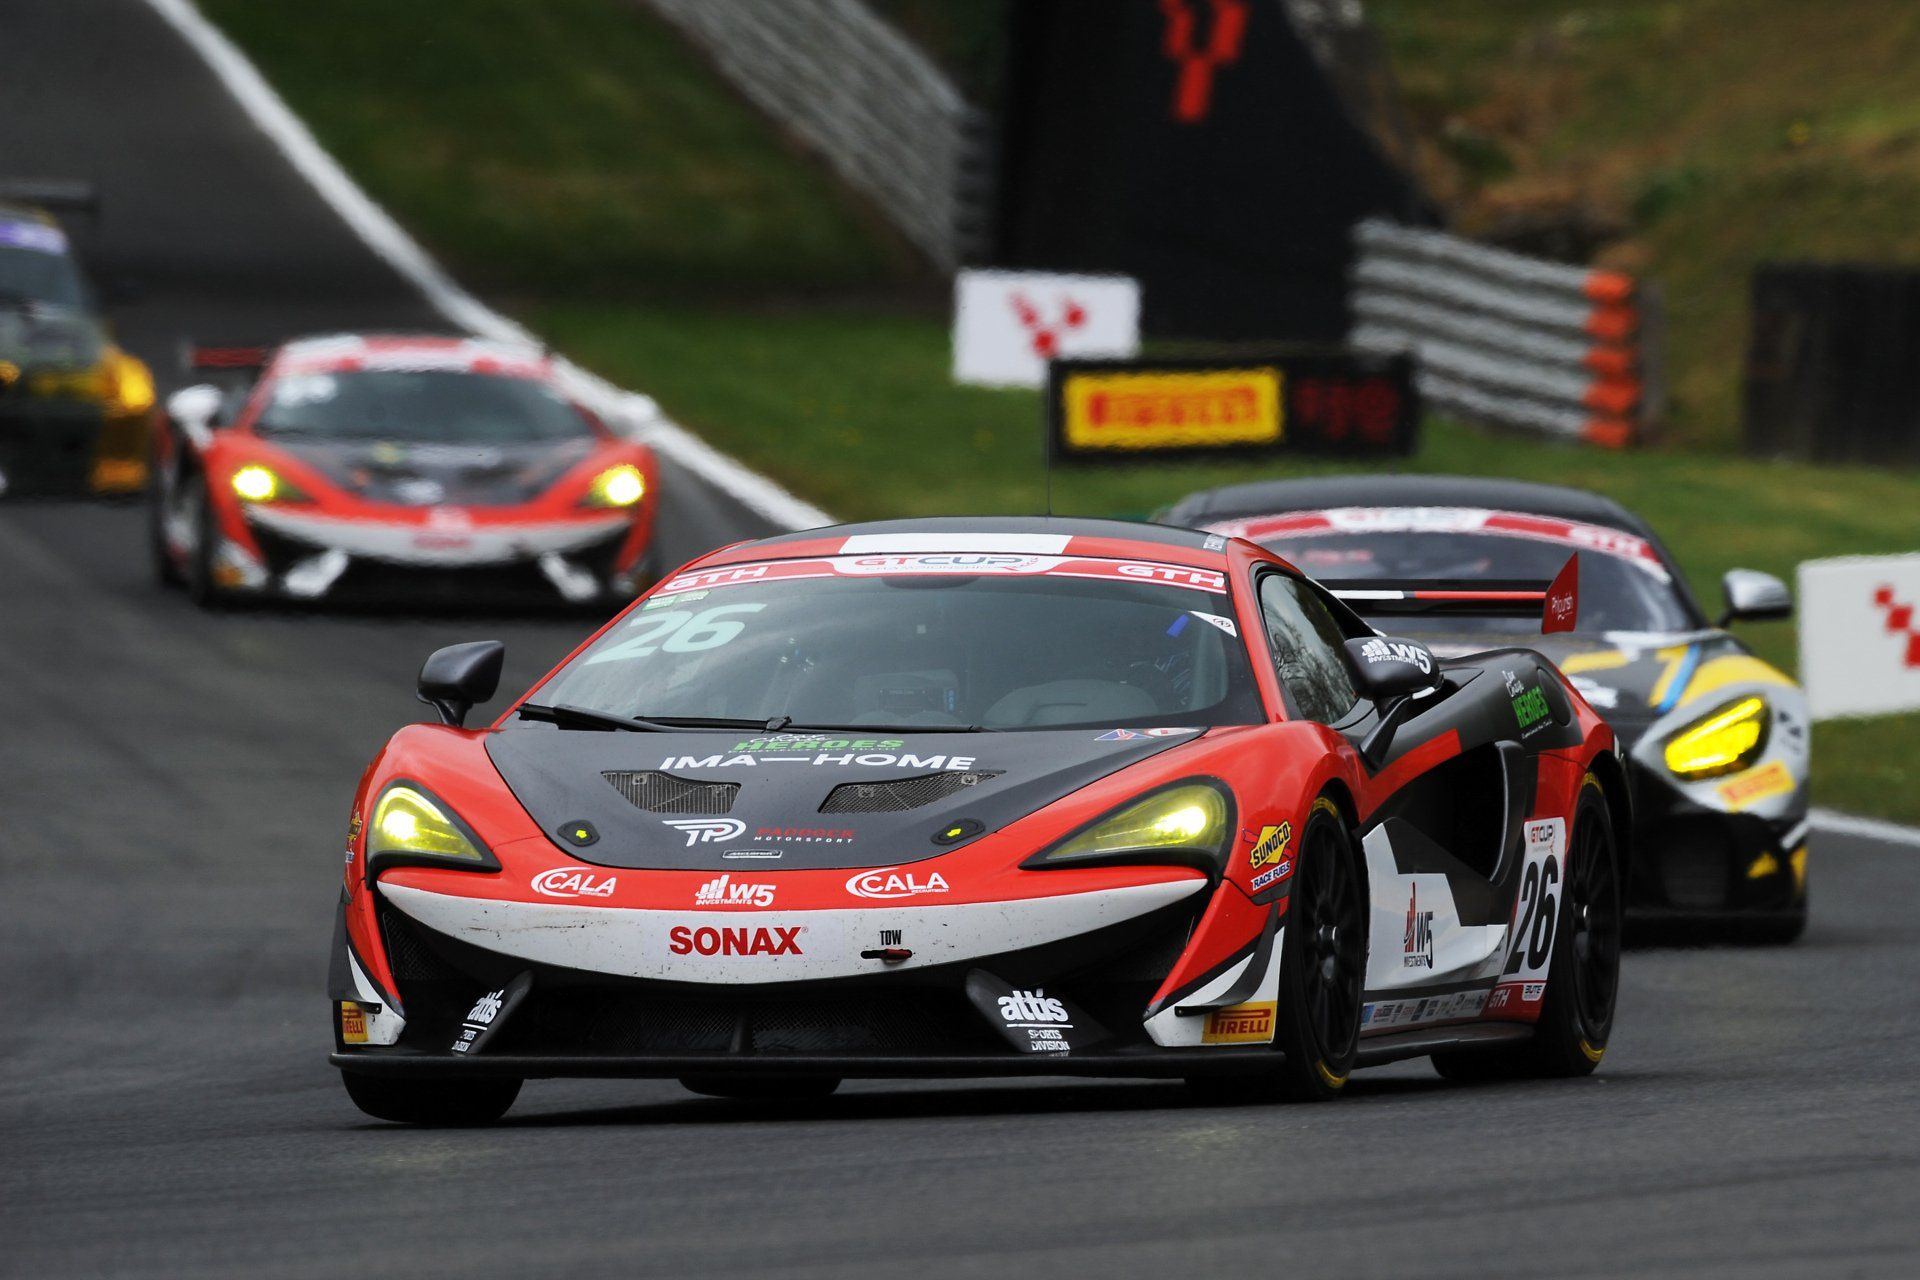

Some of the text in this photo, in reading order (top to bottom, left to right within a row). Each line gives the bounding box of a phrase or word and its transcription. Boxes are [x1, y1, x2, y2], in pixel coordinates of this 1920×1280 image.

[663, 566, 770, 591] GTH
[1117, 565, 1225, 588] GTH
[583, 603, 769, 666] 26
[1368, 654, 1419, 667] INVESTMENTS
[1388, 643, 1431, 675] W5
[1512, 686, 1550, 729] HEROES
[734, 739, 905, 751] HEROES
[753, 836, 853, 844] MOTORSPORT
[1252, 823, 1290, 867] SUNOCO
[544, 872, 617, 894] CALA
[861, 872, 950, 893] CALA
[1253, 860, 1291, 889] RACE FUELS
[695, 898, 753, 906] INVESTMENTS
[729, 883, 777, 907] W5
[1502, 854, 1559, 976] 26
[669, 926, 803, 956] SONAX
[879, 929, 903, 946] TOW
[1416, 911, 1434, 969] W5
[997, 988, 1069, 1023] attis
[1210, 1007, 1272, 1035] PIRELLI
[1028, 1029, 1062, 1040] SPORTS
[1031, 1040, 1070, 1051] DIVISION
